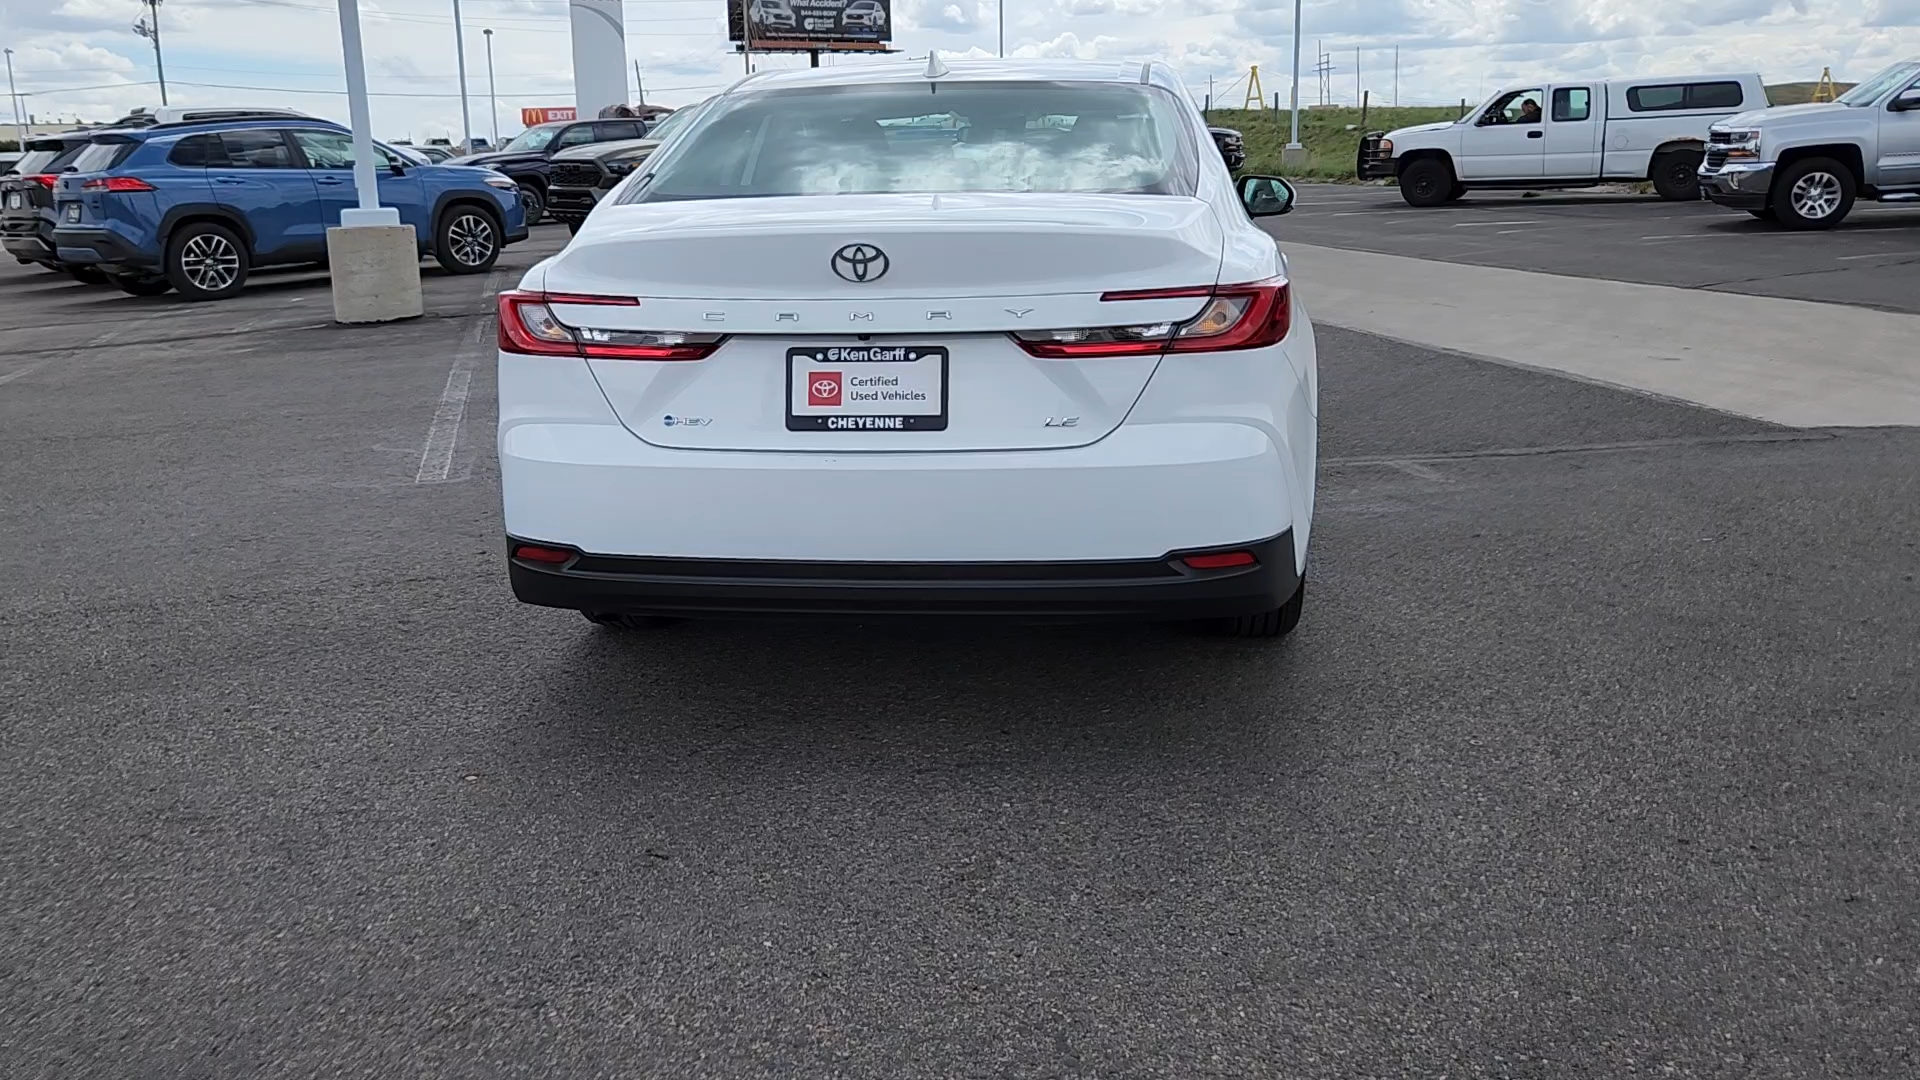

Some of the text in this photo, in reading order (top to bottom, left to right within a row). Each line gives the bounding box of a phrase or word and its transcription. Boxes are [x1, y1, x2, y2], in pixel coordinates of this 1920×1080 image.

[810, 0, 848, 8] Accident?
[547, 110, 574, 121] EXIT
[702, 308, 1035, 323] CAMRY
[840, 347, 905, 361] Ken Garff
[850, 376, 898, 387] Certified
[850, 390, 926, 401] Used Vehicles
[827, 416, 904, 429] CHEYENNE
[1044, 416, 1080, 428] LE
